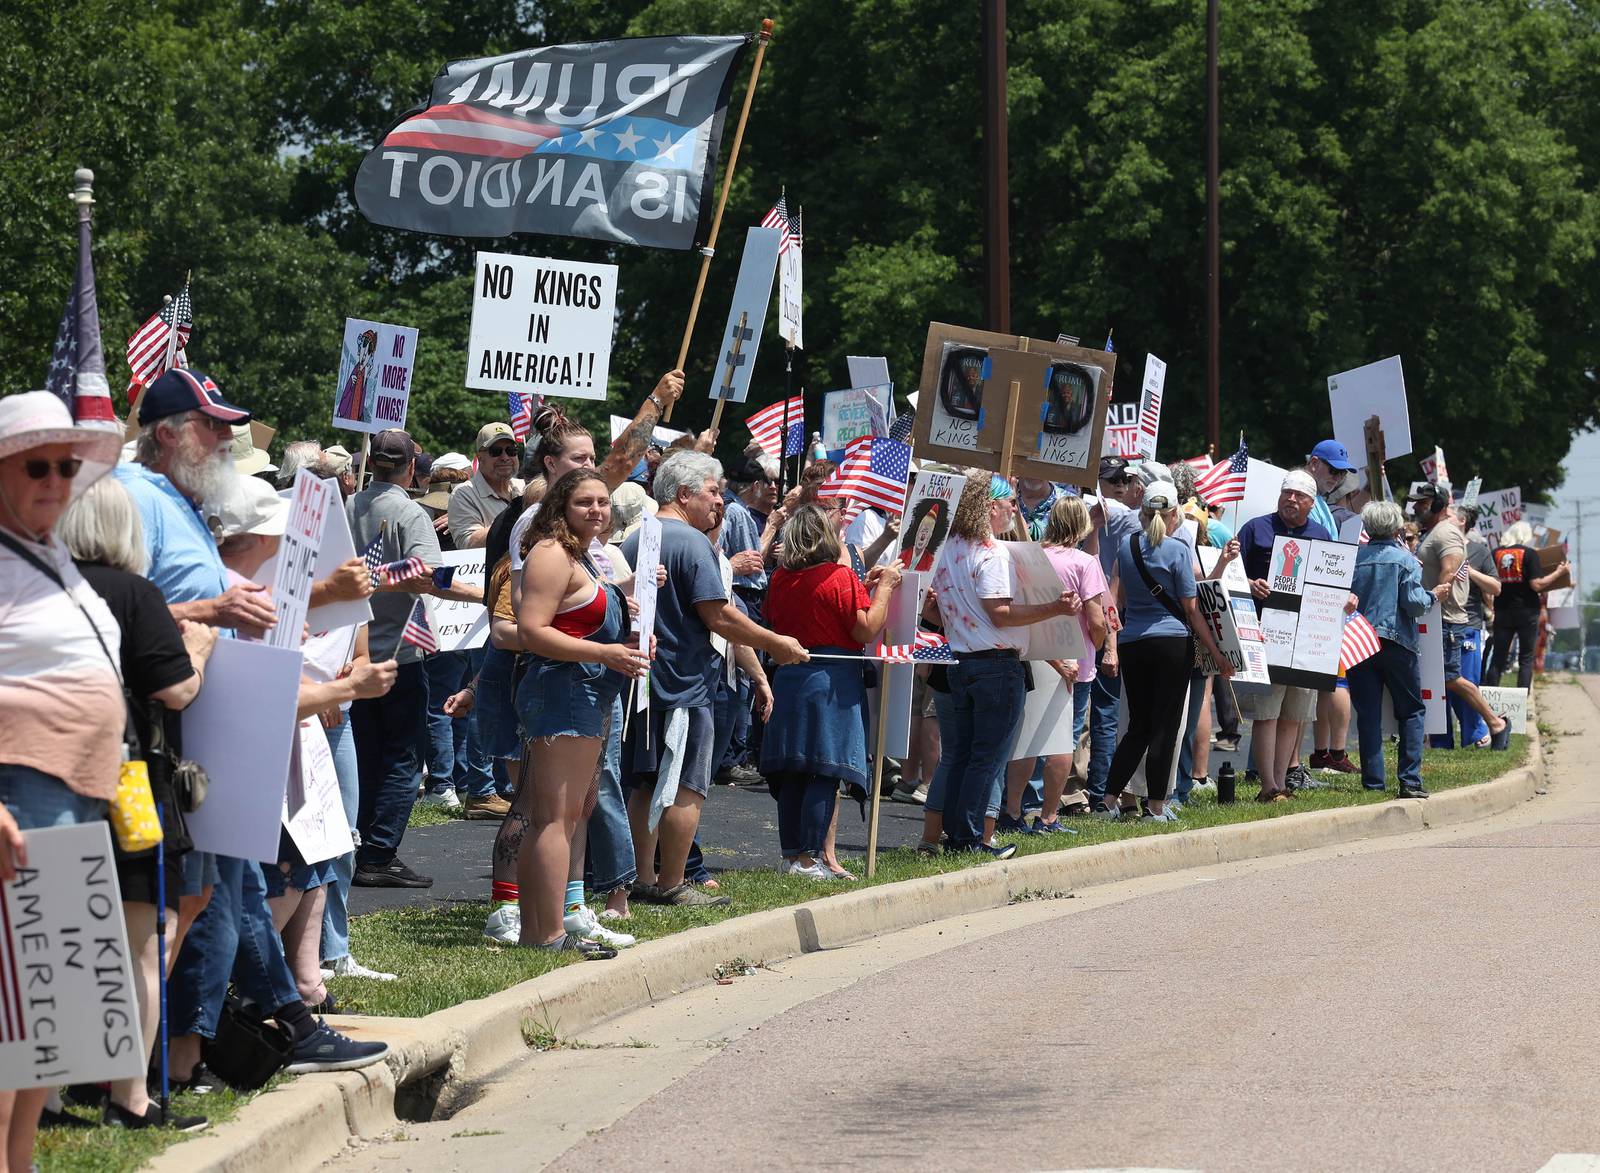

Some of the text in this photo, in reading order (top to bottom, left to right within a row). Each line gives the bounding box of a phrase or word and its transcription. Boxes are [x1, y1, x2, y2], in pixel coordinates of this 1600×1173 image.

[482, 263, 602, 310] NO KINGS
[527, 313, 550, 344] IN
[392, 334, 406, 359] NO
[381, 364, 407, 391] MORE
[479, 350, 595, 388] AMERICA!!
[375, 395, 405, 423] KINGS!
[1106, 404, 1137, 425] NO
[949, 418, 972, 431] NO
[1048, 435, 1067, 448] NO
[1042, 448, 1086, 466] INGS!
[930, 474, 951, 486] ELECT
[919, 484, 953, 499] A CLOWN
[1501, 491, 1517, 508] NO
[1476, 501, 1498, 518] AX
[1479, 519, 1493, 531] HE
[1321, 550, 1345, 561] Trump's
[1324, 559, 1338, 567] Not
[1274, 575, 1298, 584] PEOPLE
[1313, 565, 1347, 578] My Daddy
[1197, 580, 1227, 612] NDS
[1273, 582, 1297, 593] POWER
[1481, 689, 1502, 702] RMY
[1501, 703, 1521, 713] DAY
[60, 928, 85, 969] IN
[81, 855, 133, 1059] NO KINGS
[11, 867, 70, 1081] AMERICA!
